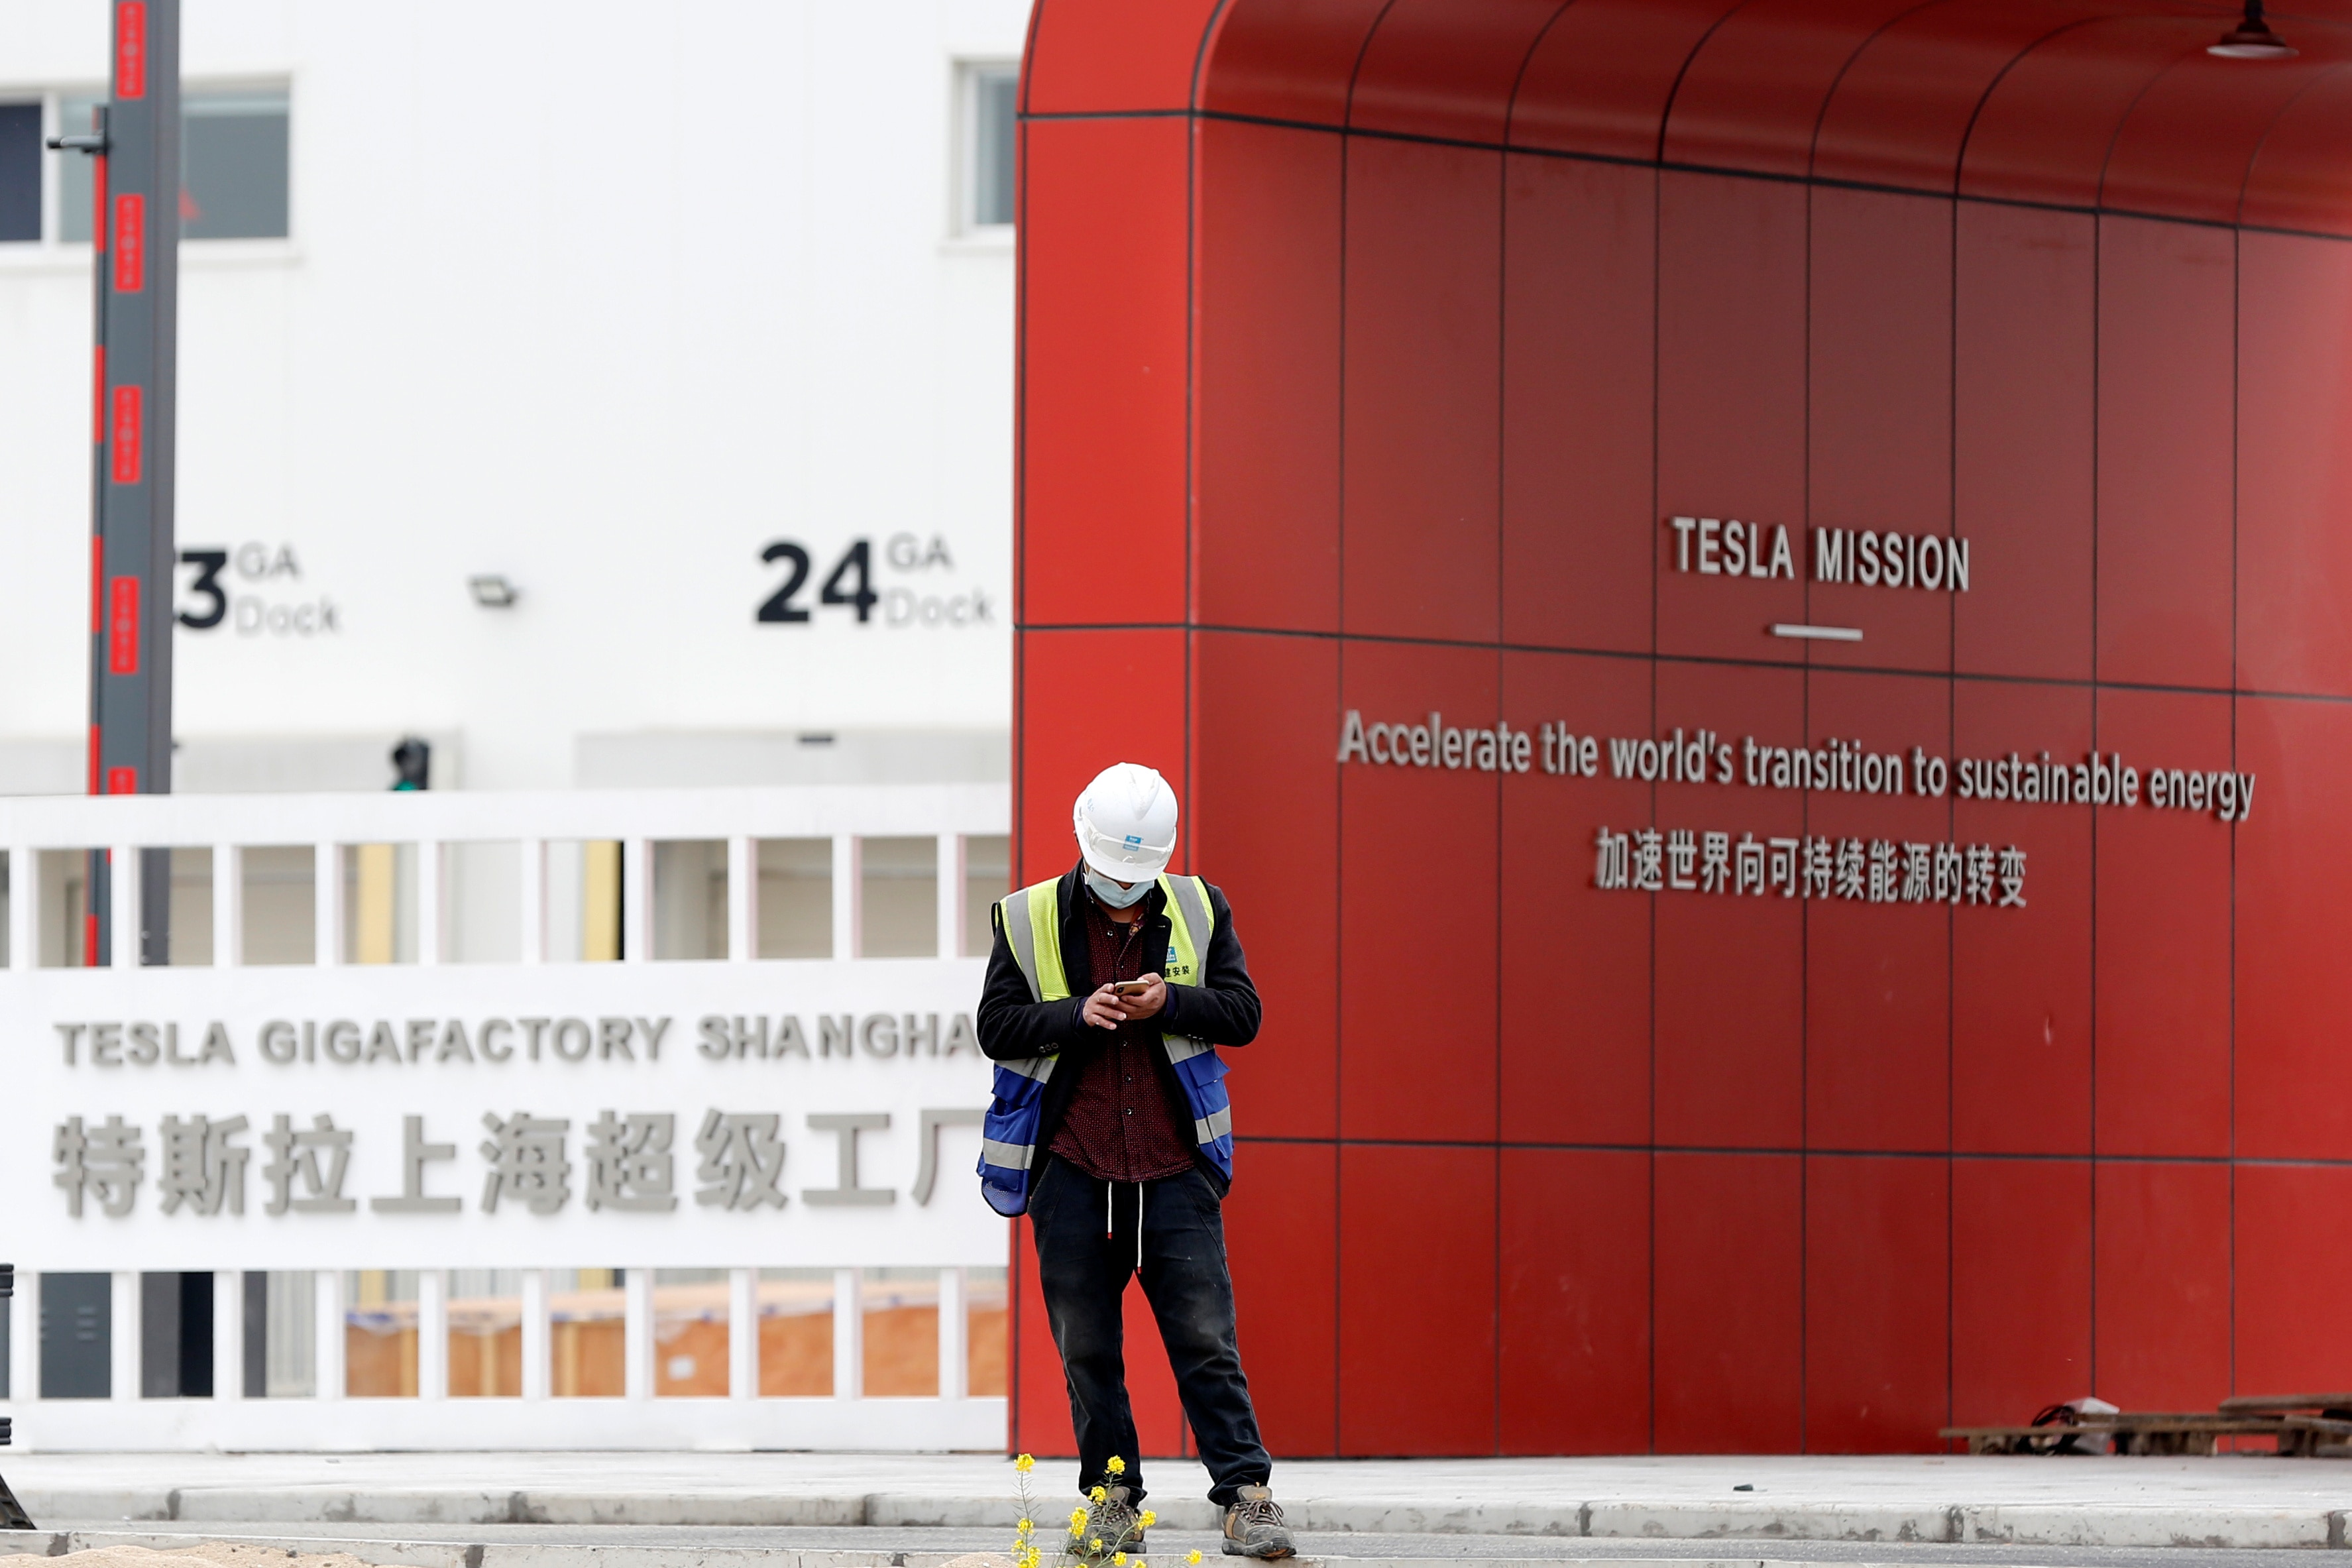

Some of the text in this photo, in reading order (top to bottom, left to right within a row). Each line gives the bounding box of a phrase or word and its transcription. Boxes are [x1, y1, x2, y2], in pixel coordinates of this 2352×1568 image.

[175, 549, 227, 631] 3
[235, 540, 302, 583] GA
[756, 539, 878, 625] 24
[886, 532, 954, 574] GA
[1673, 516, 1970, 592] TESLA MISSION
[234, 595, 341, 638] Dock
[886, 586, 995, 630] Dock
[1337, 710, 2256, 822] Accelerate the world's transition to sustainable energy
[1595, 826, 2028, 908] 加速世界向可持续能源的转变
[53, 1013, 982, 1068] TESLA GIGAFACTORY SHANGHA
[52, 1107, 985, 1219] 特斯拉上海超级工厂
